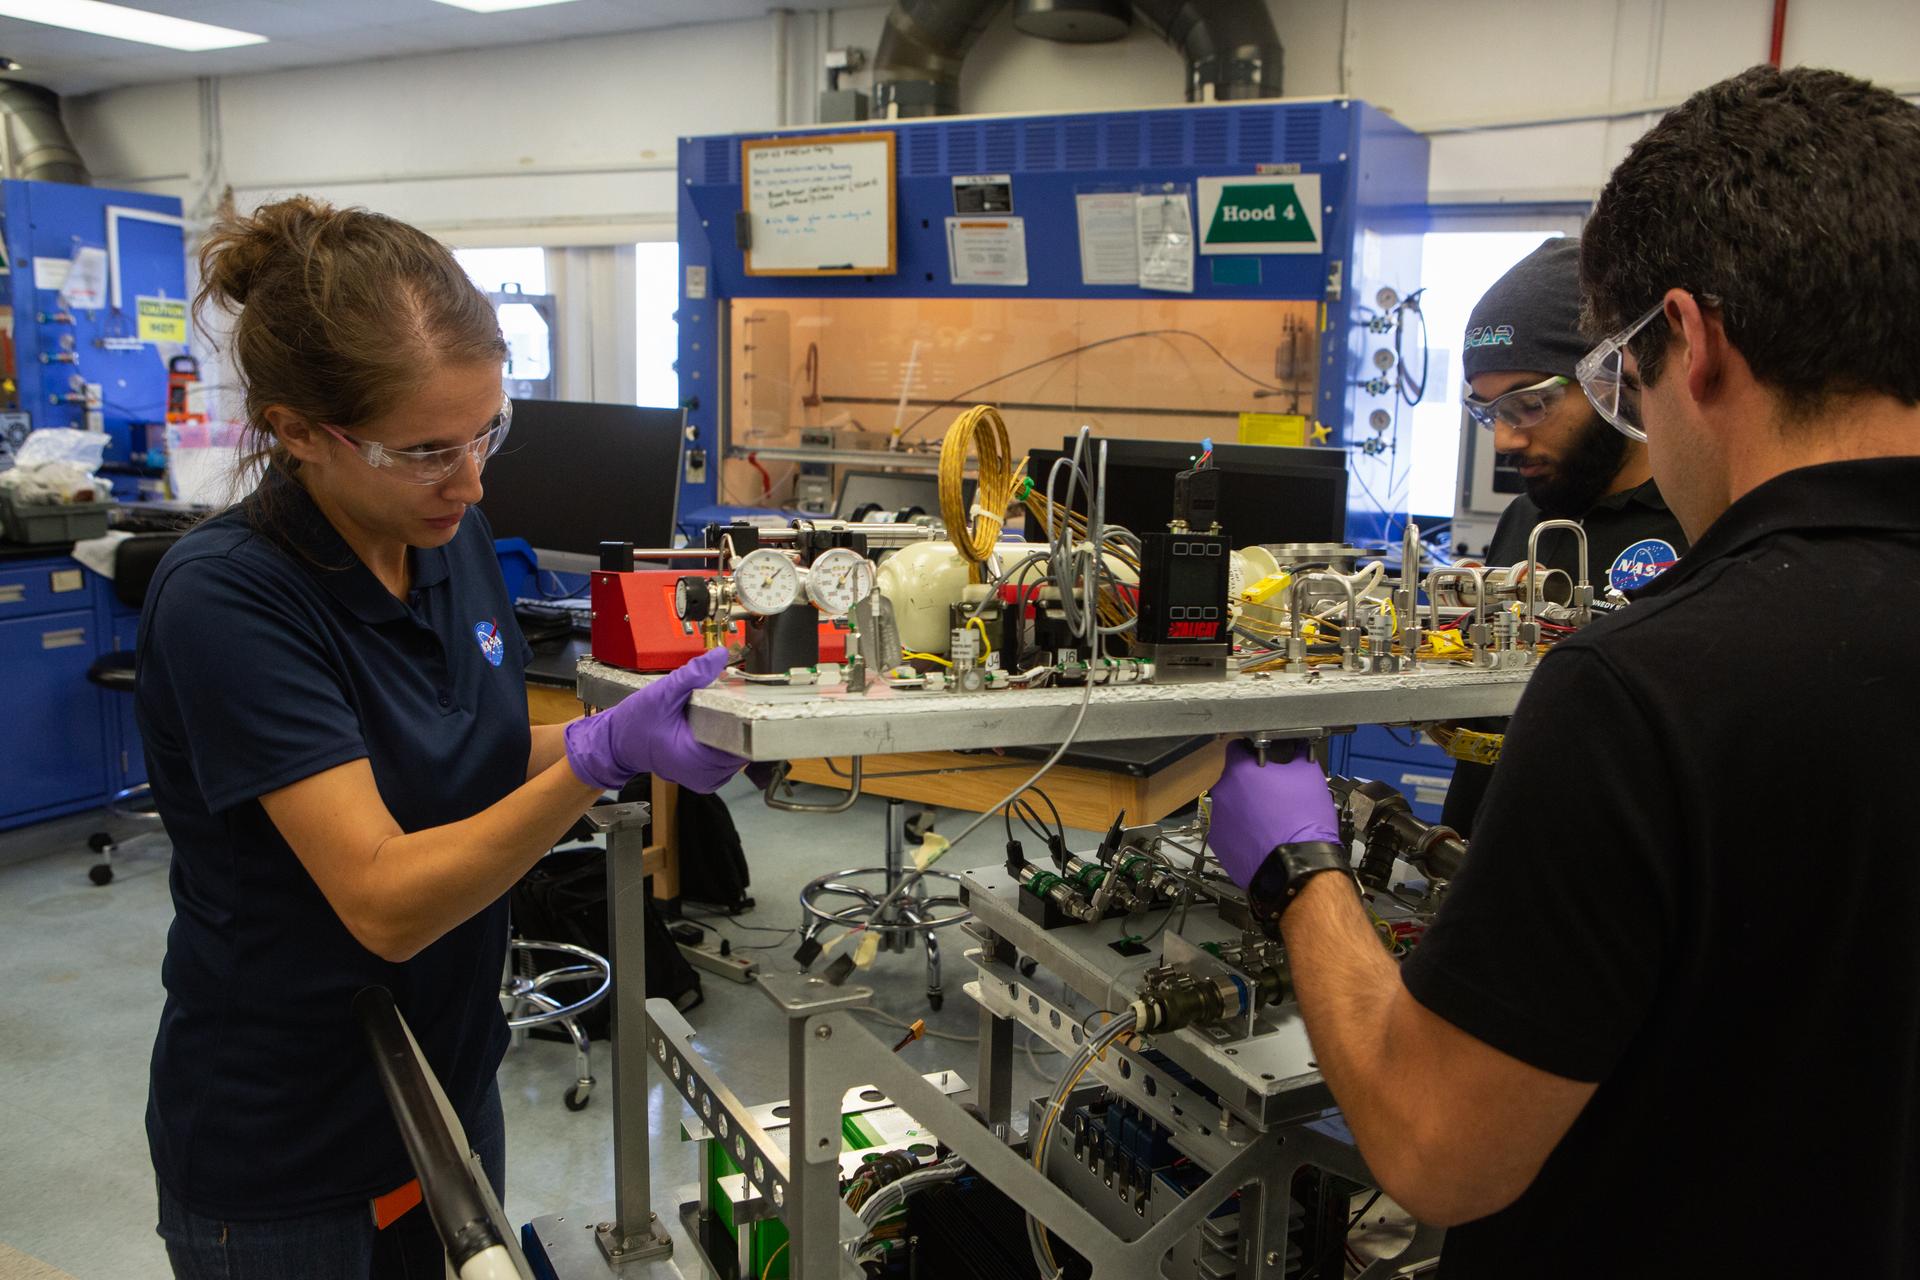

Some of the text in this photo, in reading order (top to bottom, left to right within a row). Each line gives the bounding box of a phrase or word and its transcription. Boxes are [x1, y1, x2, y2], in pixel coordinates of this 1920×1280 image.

[1222, 204, 1296, 222] Hood 4
[987, 654, 999, 668] J4
[1061, 651, 1075, 664] J6
